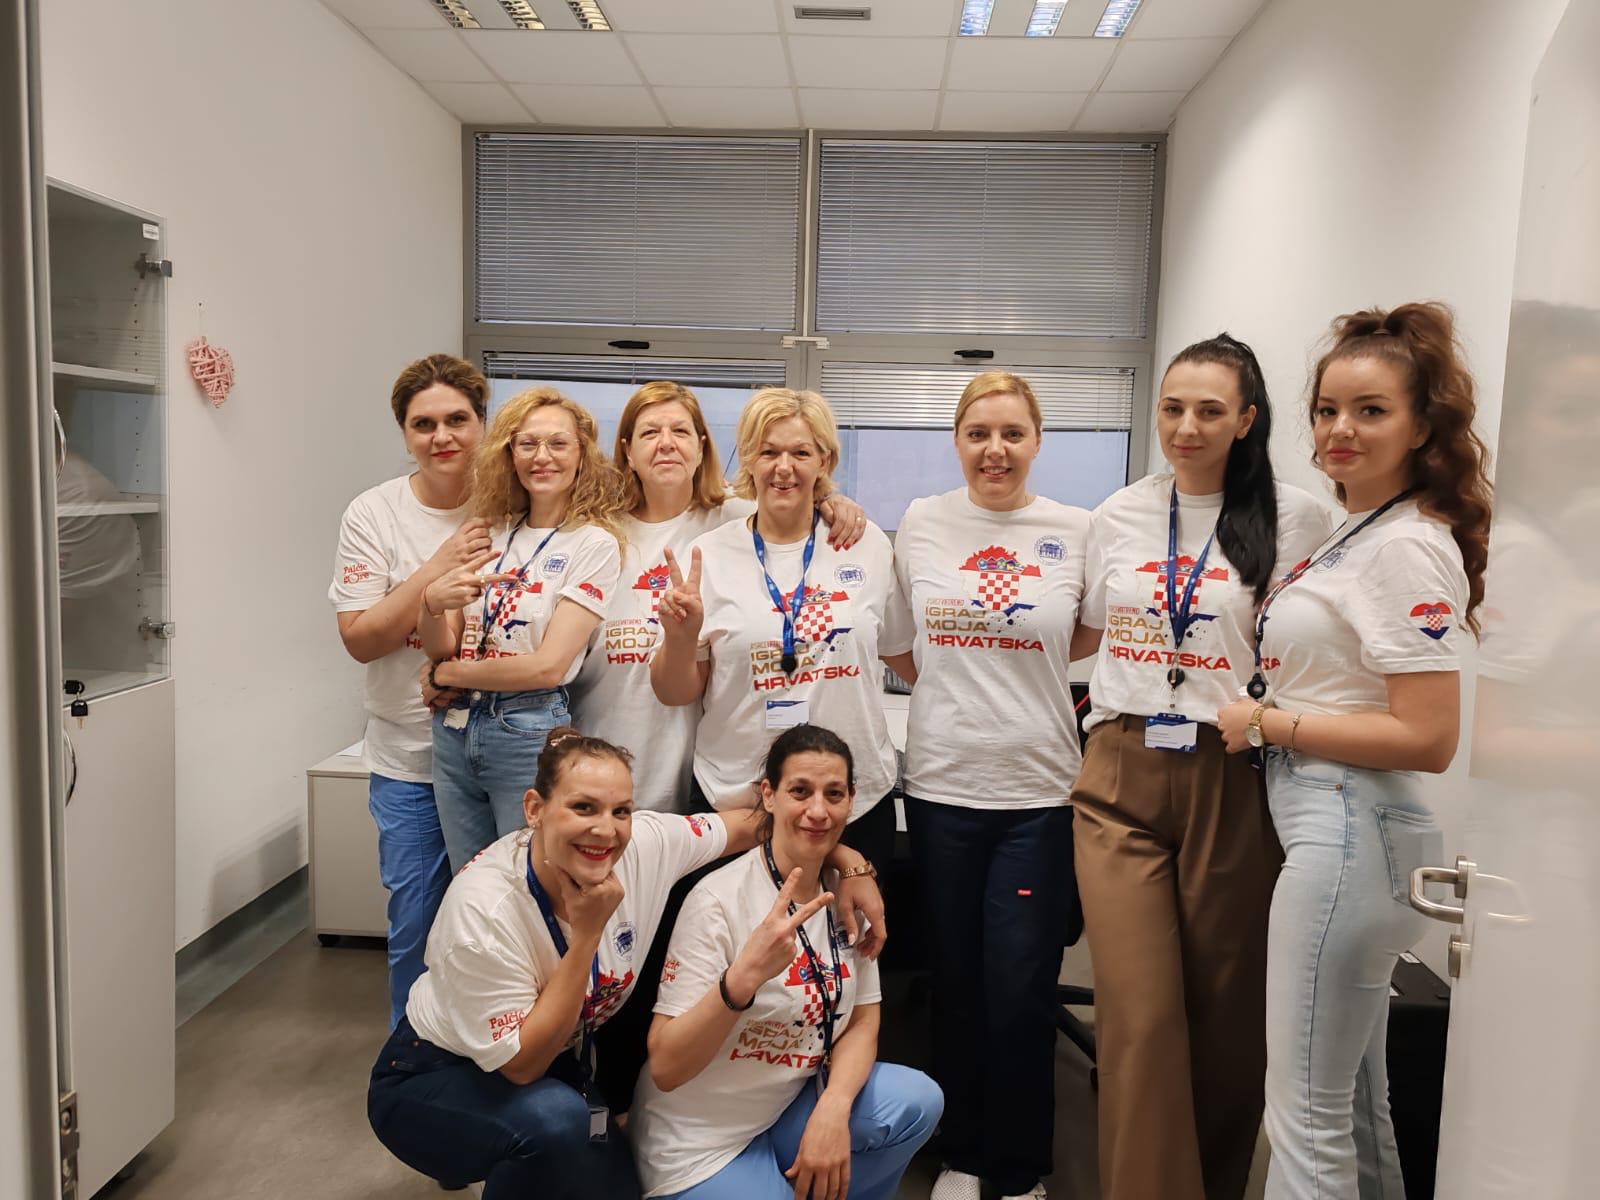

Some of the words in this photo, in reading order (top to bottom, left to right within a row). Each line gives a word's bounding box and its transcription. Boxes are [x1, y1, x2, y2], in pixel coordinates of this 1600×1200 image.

[925, 606, 987, 619] IGRAJ
[925, 618, 988, 633] MOJA
[1110, 614, 1165, 631] GRAJ
[927, 633, 1045, 652] HRVATSKA
[1106, 626, 1167, 646] MOJA
[1108, 643, 1232, 671] HRVATSKA
[753, 664, 861, 692] HRVATSKA
